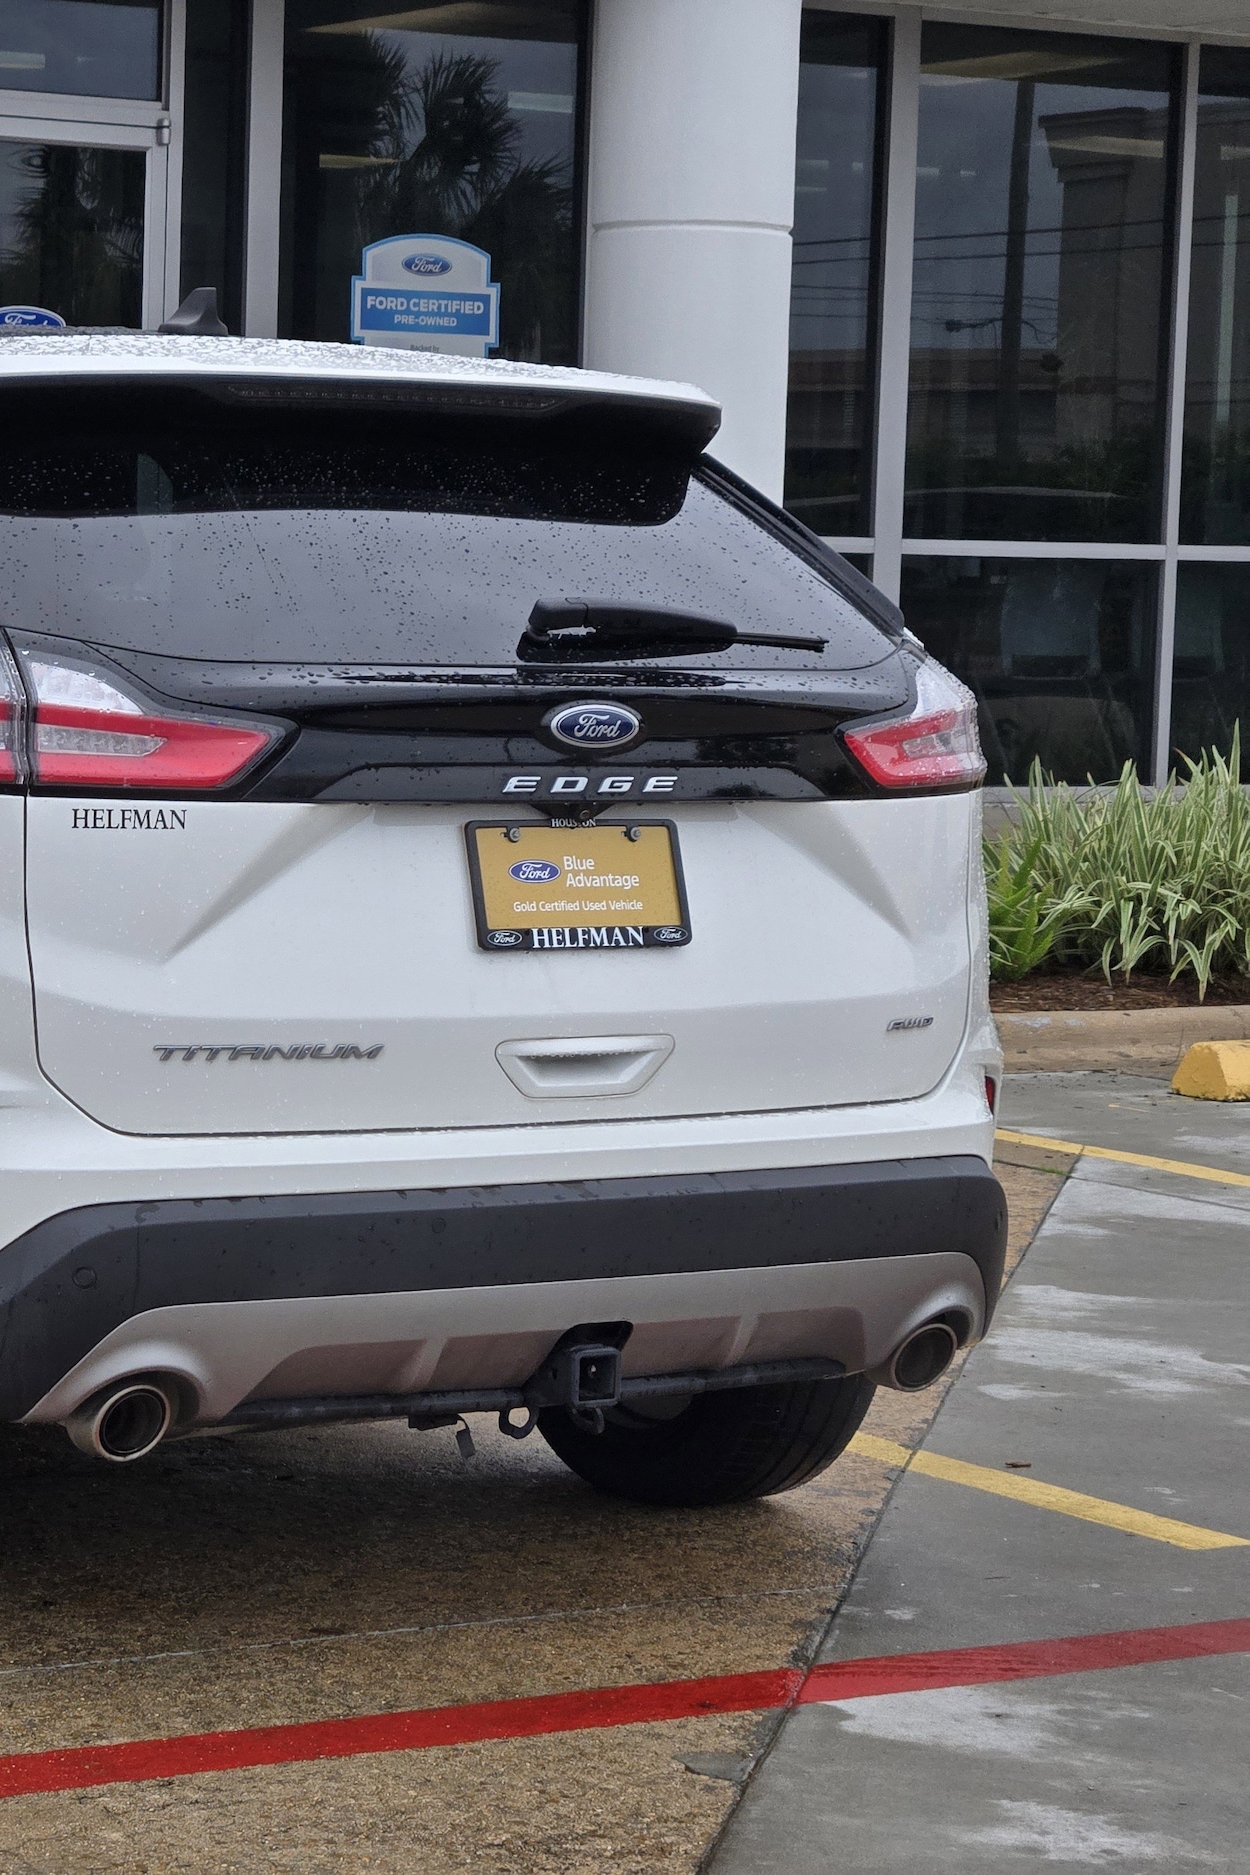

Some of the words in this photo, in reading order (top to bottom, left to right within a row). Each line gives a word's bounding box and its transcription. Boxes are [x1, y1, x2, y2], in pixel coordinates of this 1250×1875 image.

[366, 295, 407, 310] FORD
[409, 298, 485, 315] CERTIFIED
[394, 314, 458, 327] PRE-OWNED
[502, 775, 679, 794] EDGE
[71, 808, 188, 830] HELFMAN
[551, 818, 597, 828] HOUSON
[563, 855, 595, 871] Blue
[566, 872, 640, 890] Advantage
[513, 900, 537, 912] Gold
[539, 900, 580, 912] Certified
[582, 900, 607, 911] Used
[608, 899, 644, 911] Vehicle
[531, 926, 645, 949] HELFMAN
[886, 1016, 934, 1032] AWD
[153, 1043, 386, 1062] TITANIUM
